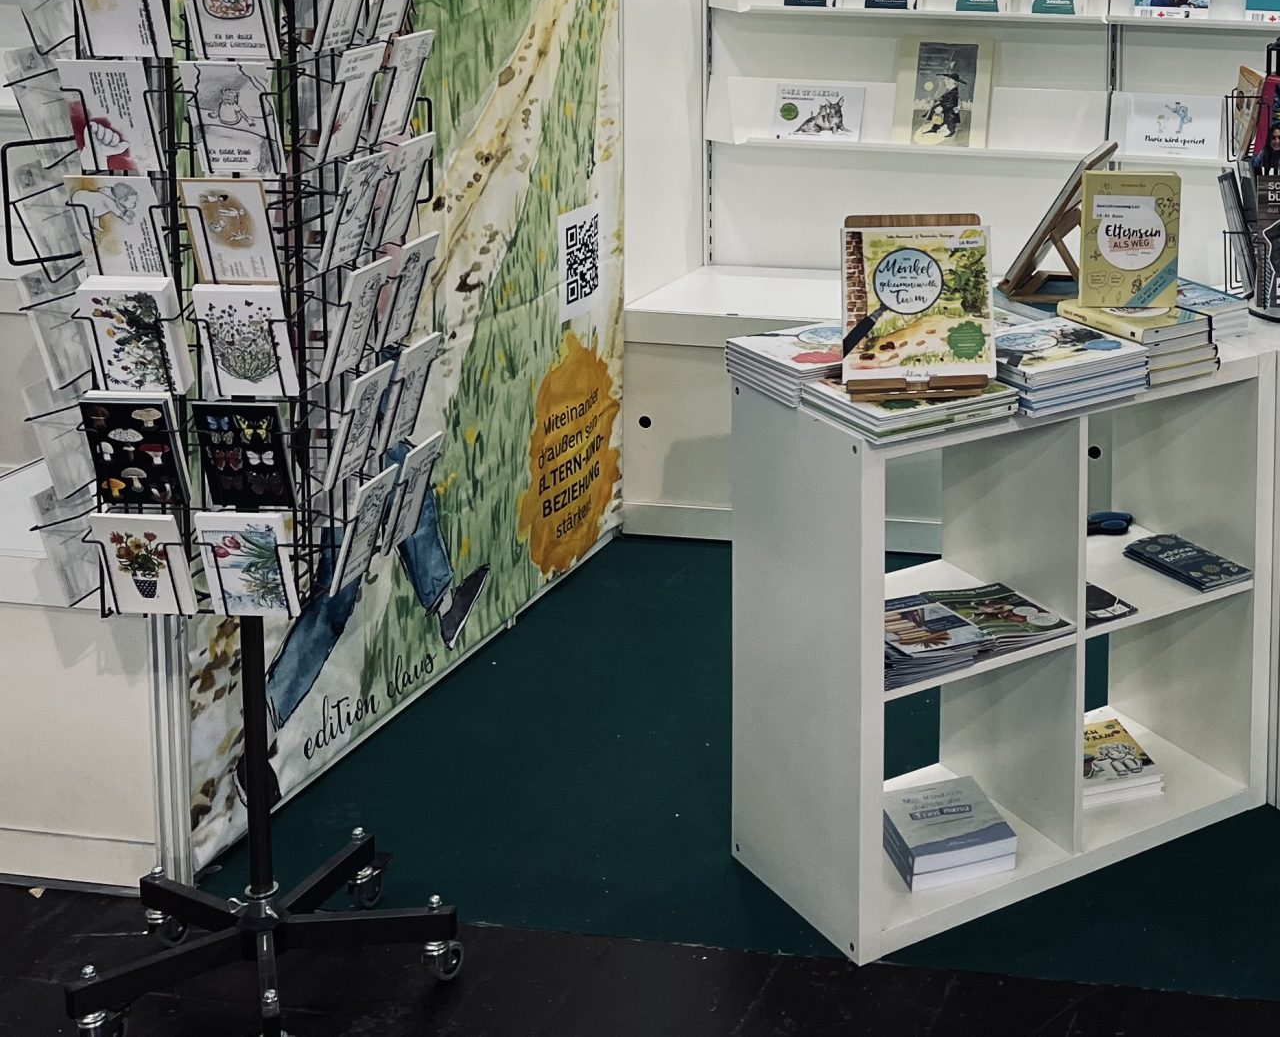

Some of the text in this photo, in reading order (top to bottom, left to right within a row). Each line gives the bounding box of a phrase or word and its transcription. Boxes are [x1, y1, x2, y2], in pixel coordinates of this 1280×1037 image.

[1105, 223, 1161, 239] Elternsein
[1112, 239, 1150, 249] ALS WEG
[543, 386, 600, 437] Miteinander
[537, 427, 584, 470] draußen
[542, 459, 600, 519] BEZIEHUNG
[303, 652, 438, 760] edition claus
